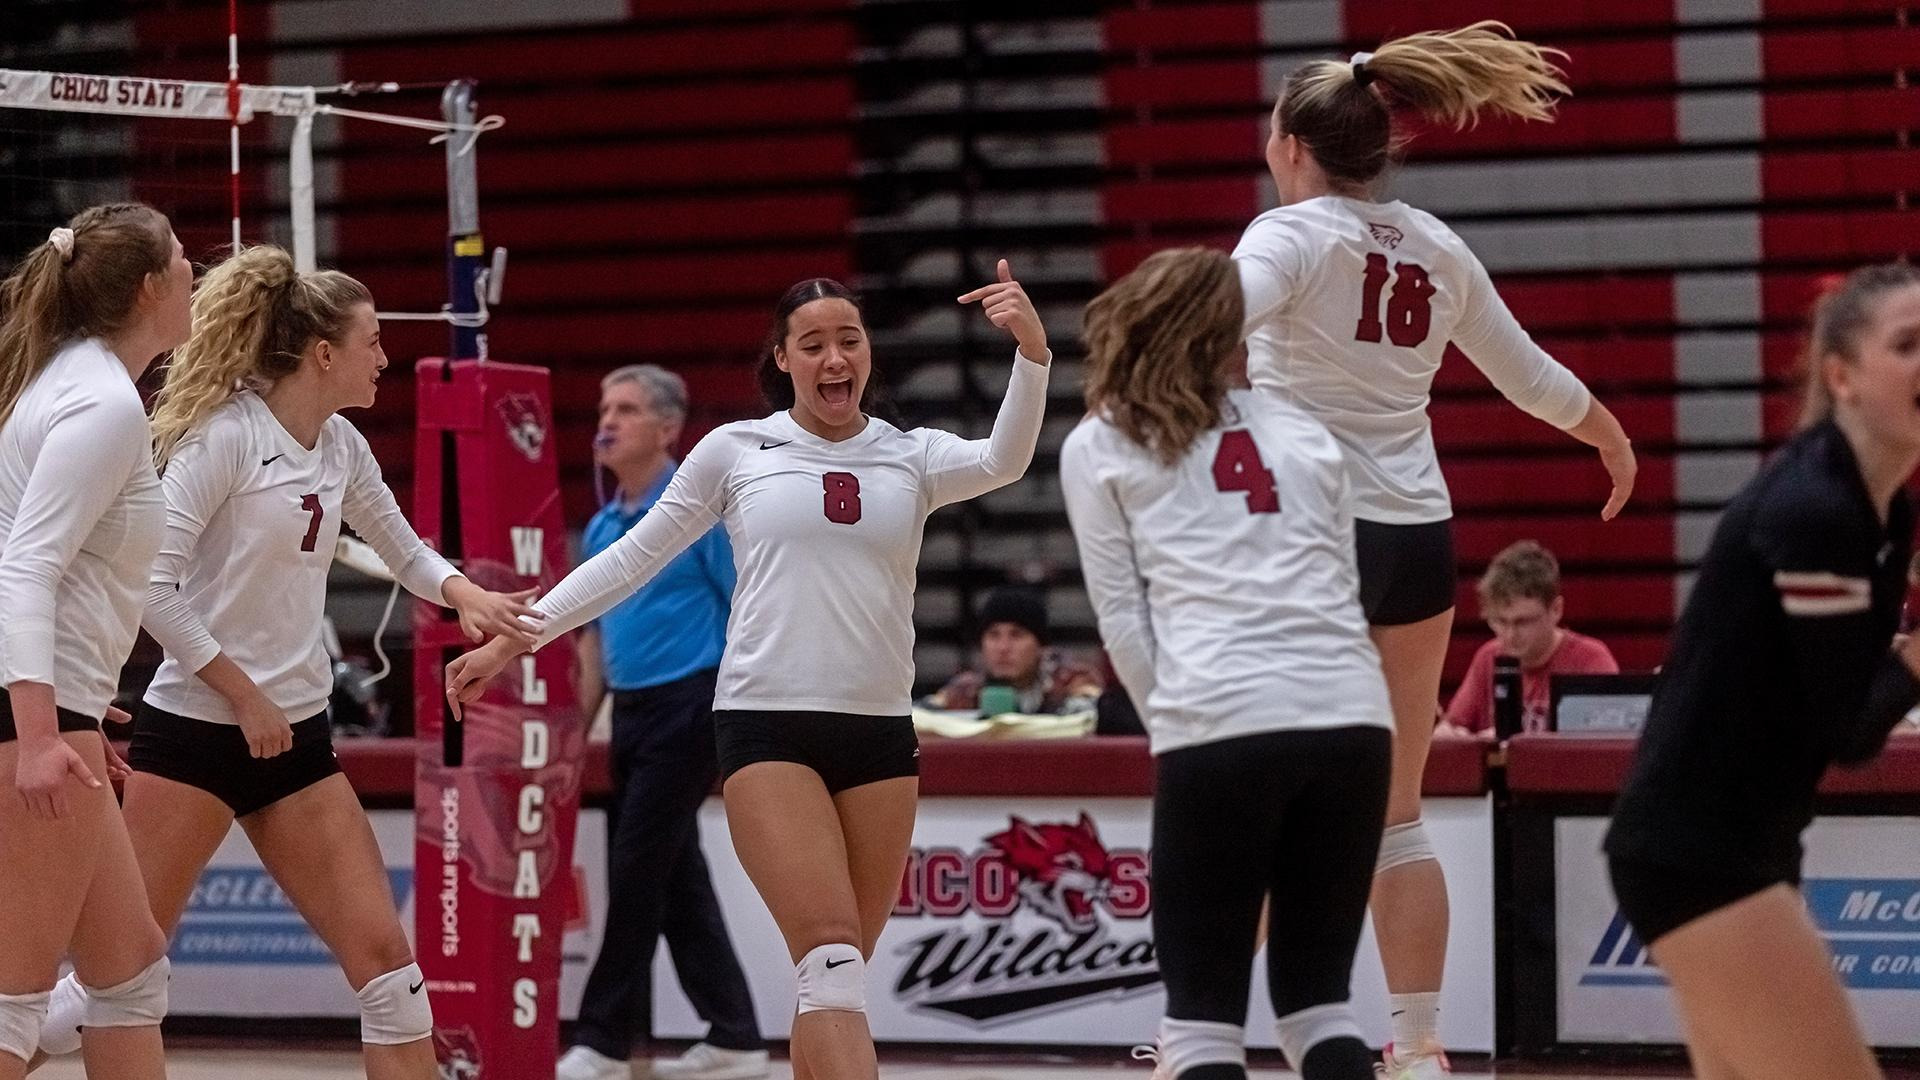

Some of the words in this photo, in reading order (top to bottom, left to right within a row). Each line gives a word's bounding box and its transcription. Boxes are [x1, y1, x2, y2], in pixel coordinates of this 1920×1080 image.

[50, 74, 109, 103] CHICO
[117, 80, 185, 109] STATE
[1354, 251, 1437, 348] 18
[822, 471, 862, 525] 8
[1211, 428, 1282, 515] 4
[510, 526, 549, 1029] WLDCATS
[441, 787, 461, 863] sports
[439, 864, 460, 957] imports
[893, 850, 1019, 918] ICO
[894, 923, 1156, 994] Wildca
